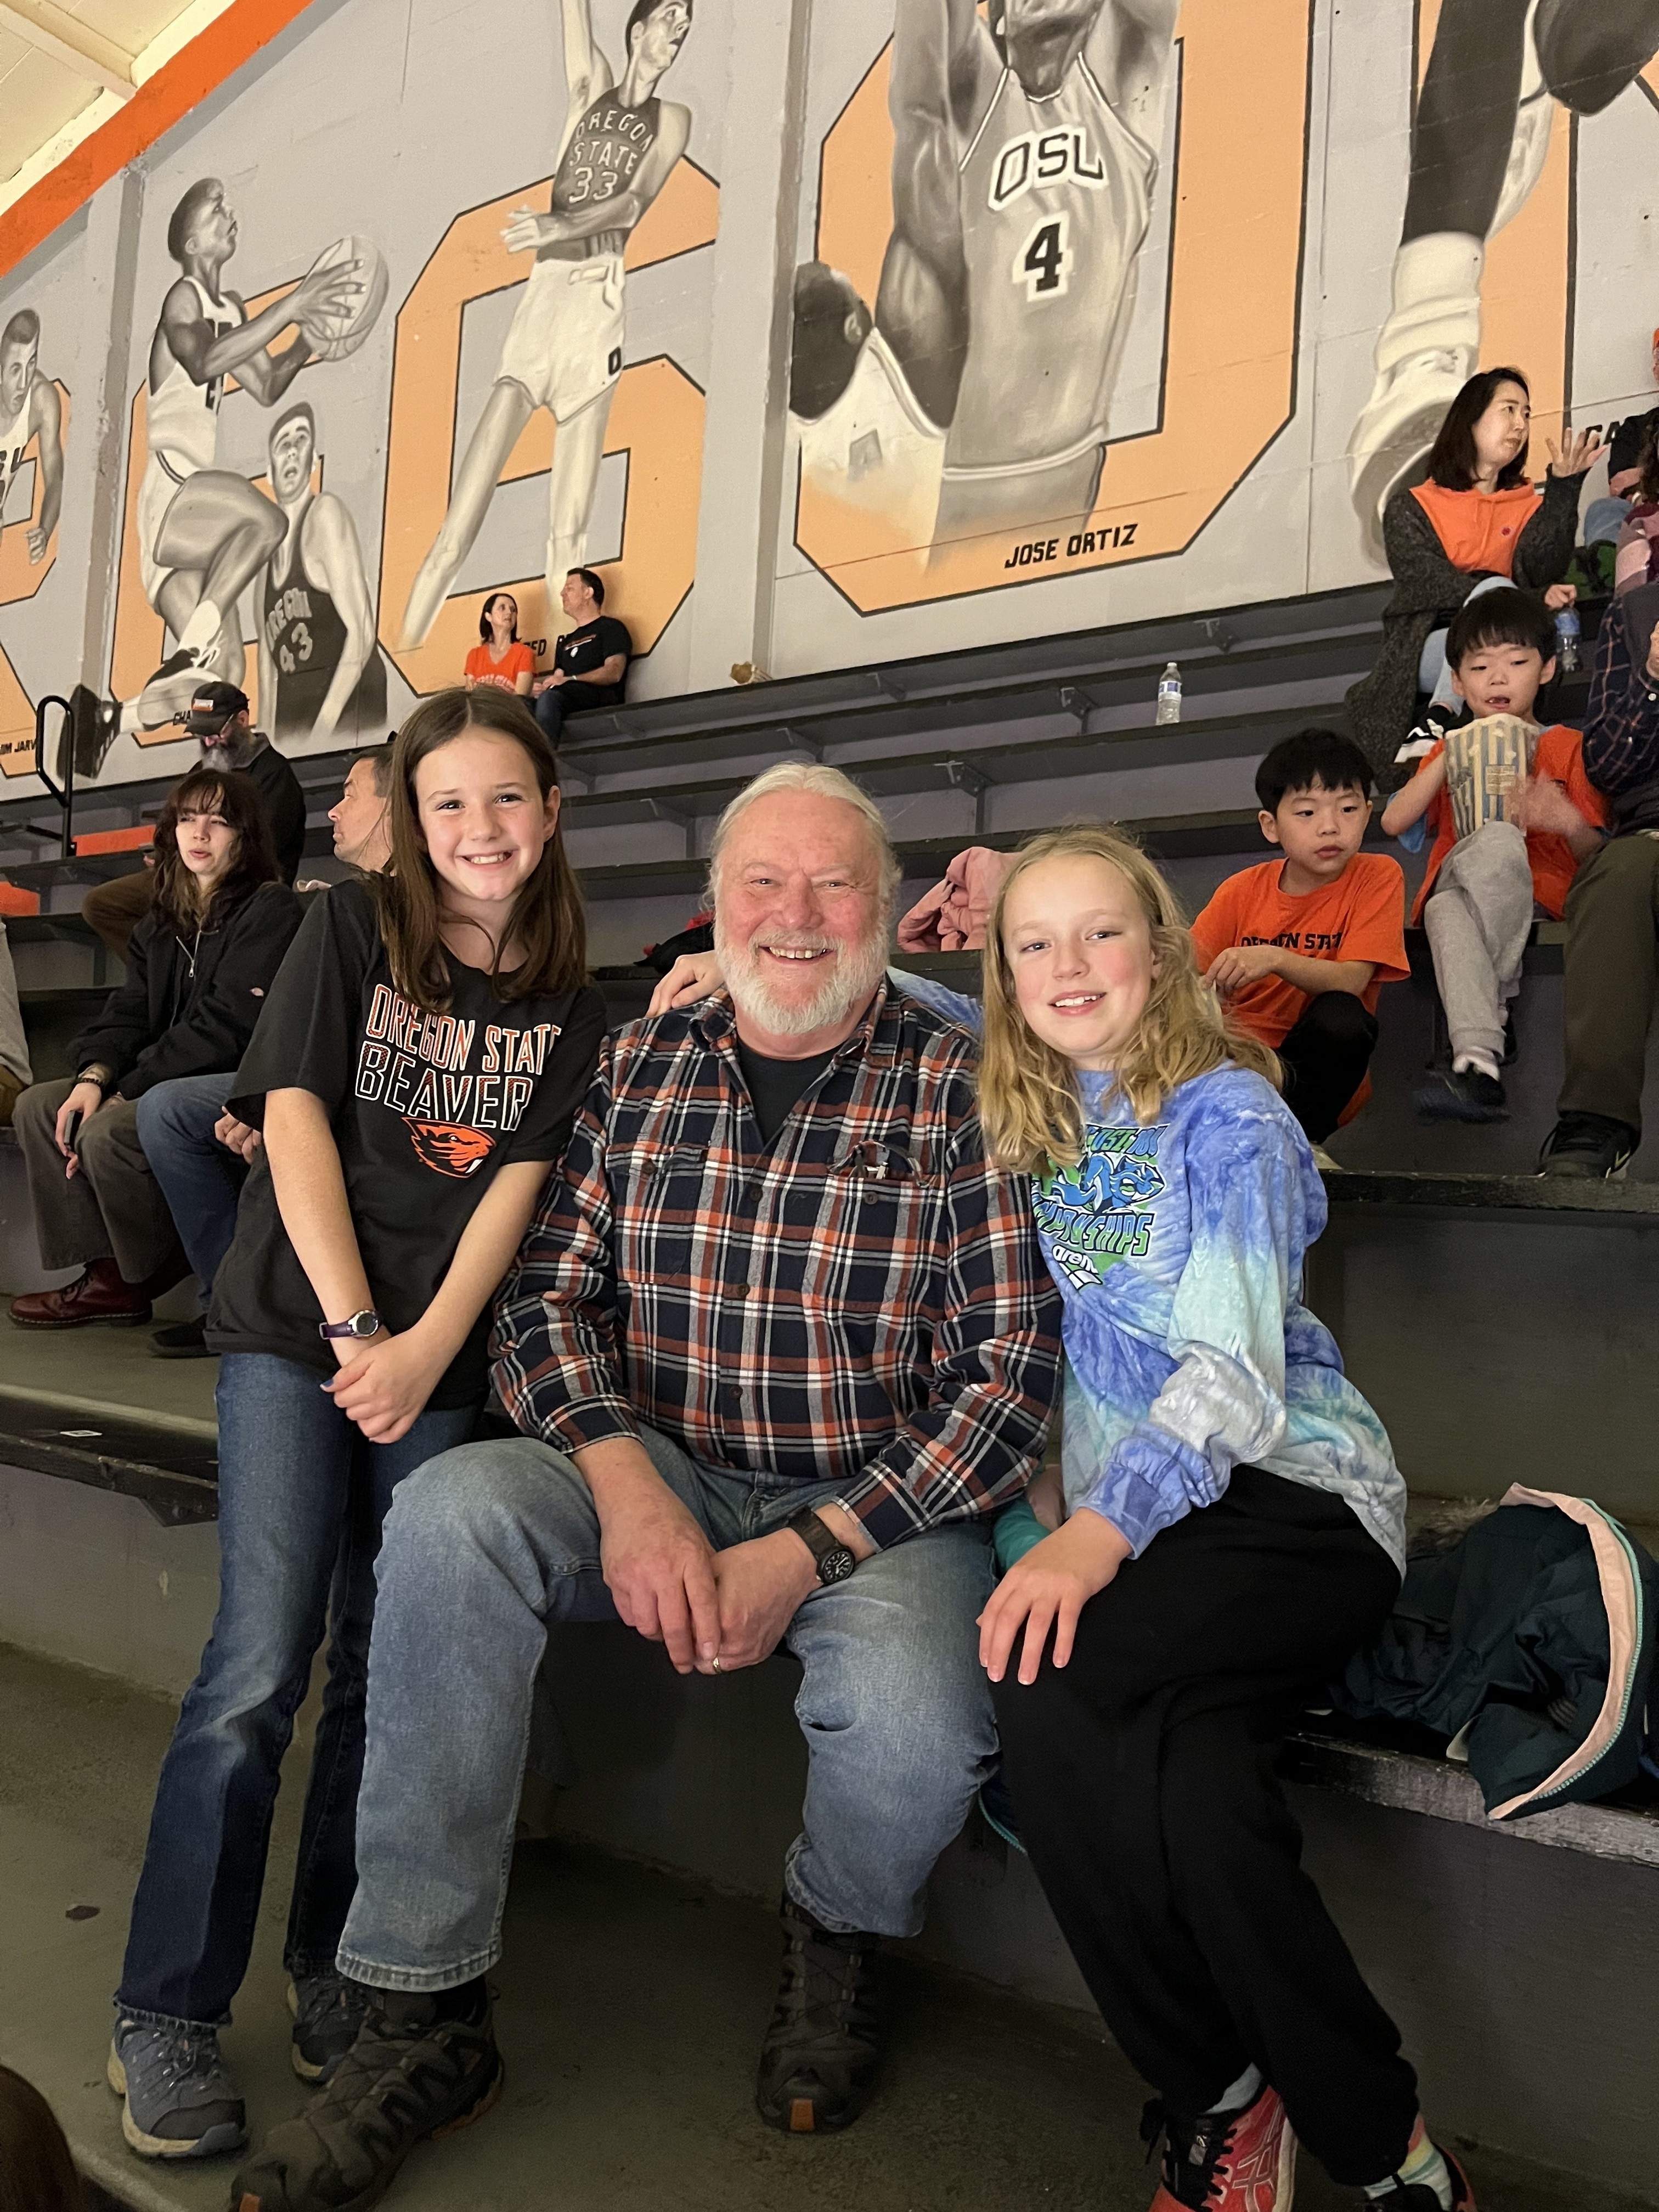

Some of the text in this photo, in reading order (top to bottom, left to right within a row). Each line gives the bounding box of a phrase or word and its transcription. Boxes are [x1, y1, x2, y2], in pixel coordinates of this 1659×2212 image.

[569, 141, 638, 175] STATE
[568, 167, 618, 204] 33
[1019, 217, 1068, 297] 4
[1005, 523, 1138, 569] JOSE ORTIZ
[366, 983, 475, 1071] OREGON
